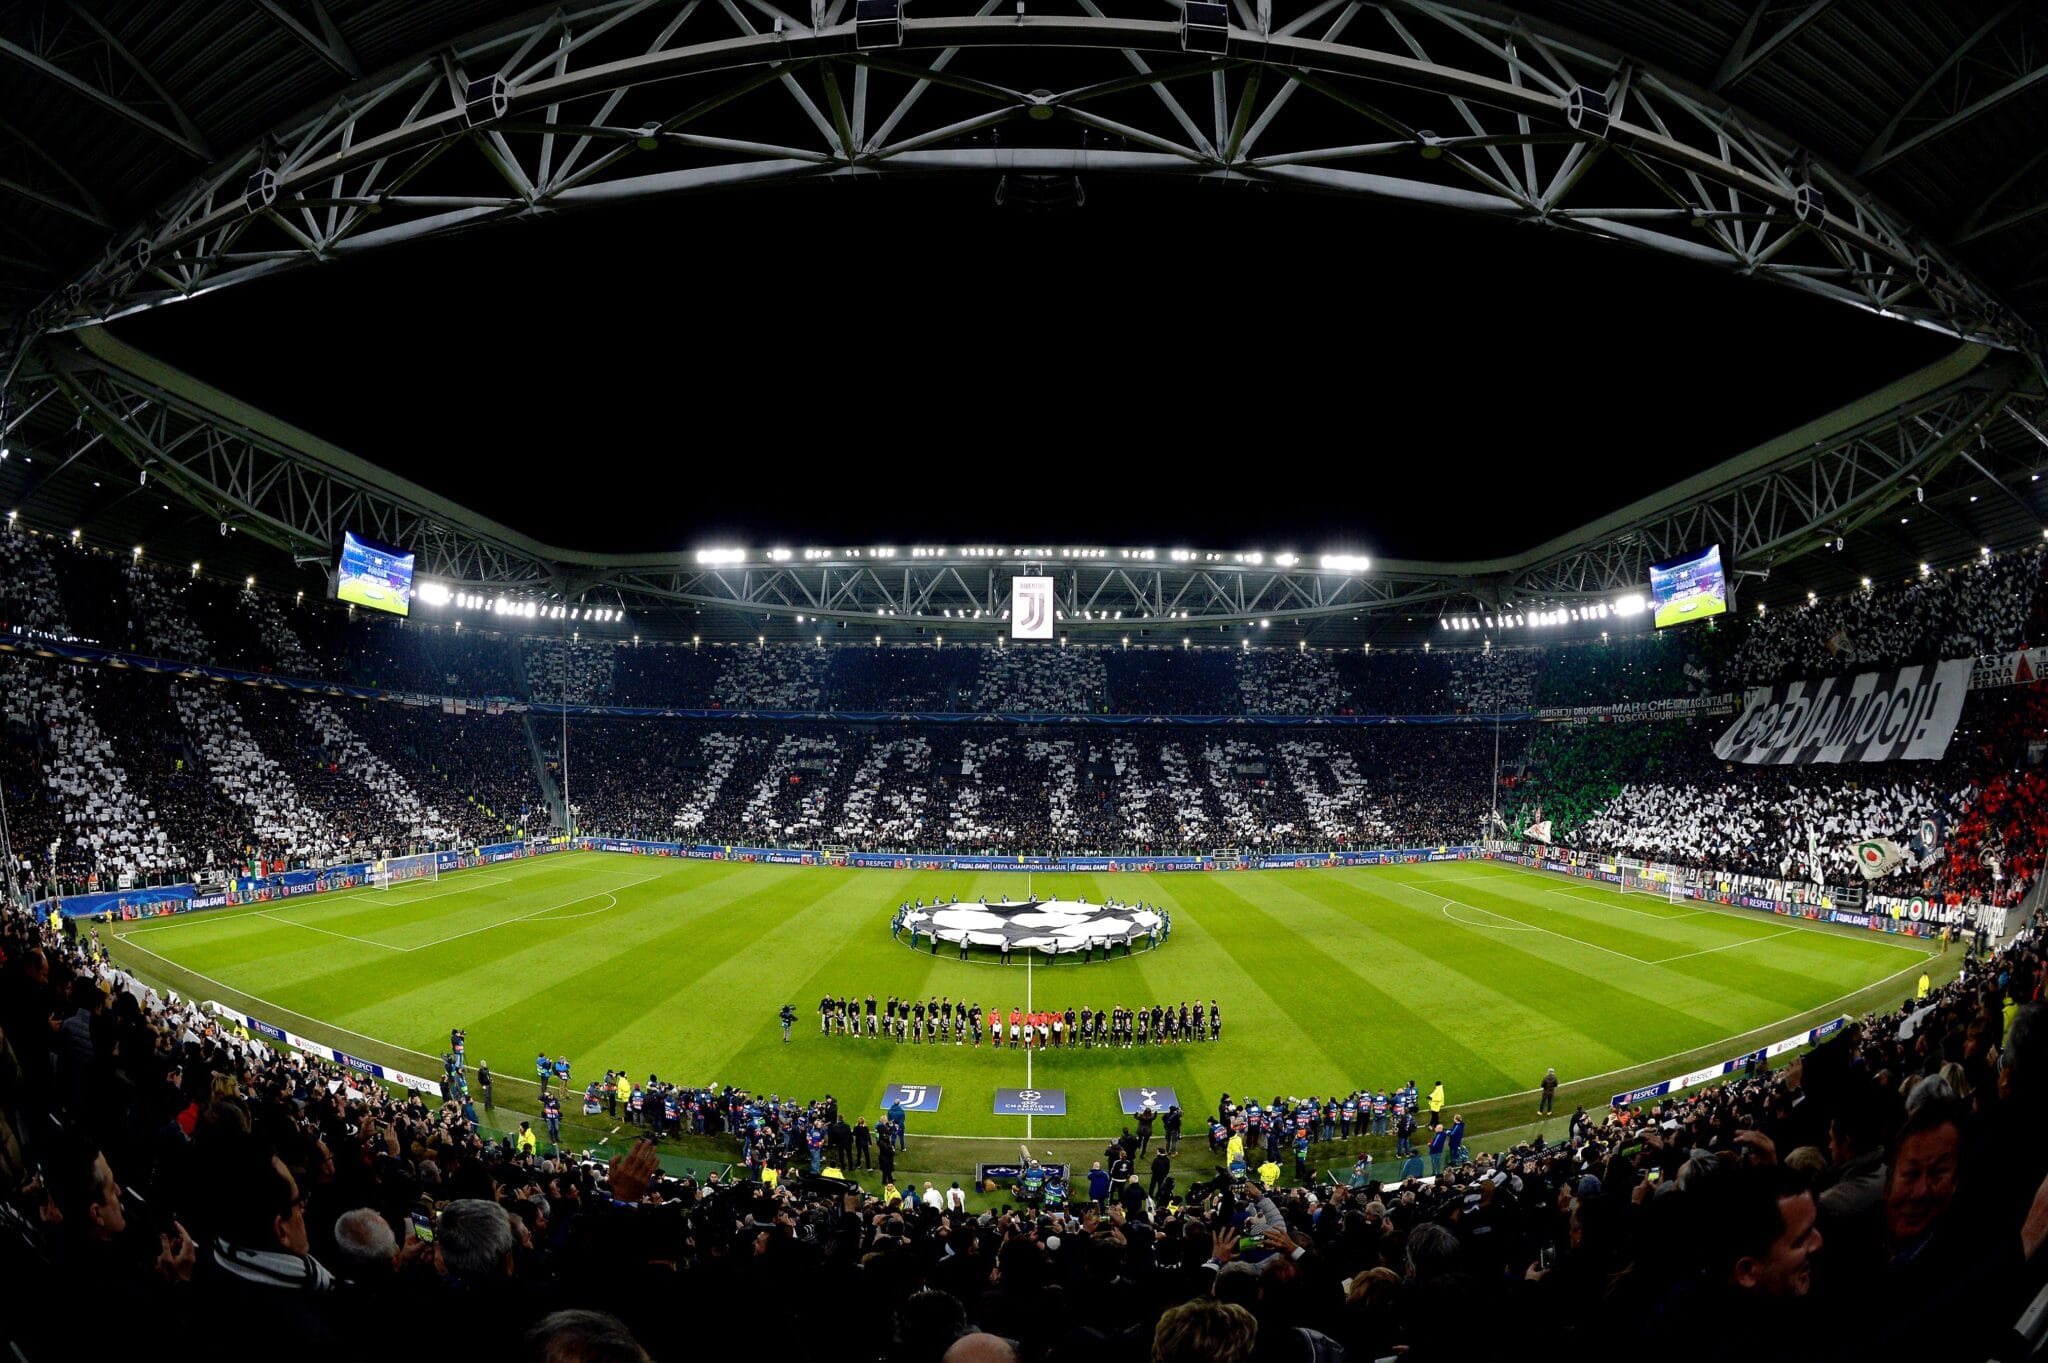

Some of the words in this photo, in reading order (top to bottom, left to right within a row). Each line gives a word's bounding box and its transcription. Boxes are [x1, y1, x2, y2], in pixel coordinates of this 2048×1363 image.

[1973, 668, 2013, 680] ZONA
[1733, 682, 1942, 748] CREDIAMOCI!
[688, 851, 712, 859] RESPECT
[440, 861, 457, 870] RESPECT
[291, 883, 314, 894] RESPECT
[1749, 899, 1774, 910] RESPECT
[350, 1059, 373, 1072] RESPECT
[1690, 1070, 1713, 1082] RESPECT
[405, 1077, 430, 1090] RESPECT
[1633, 1087, 1660, 1100] RESPECT
